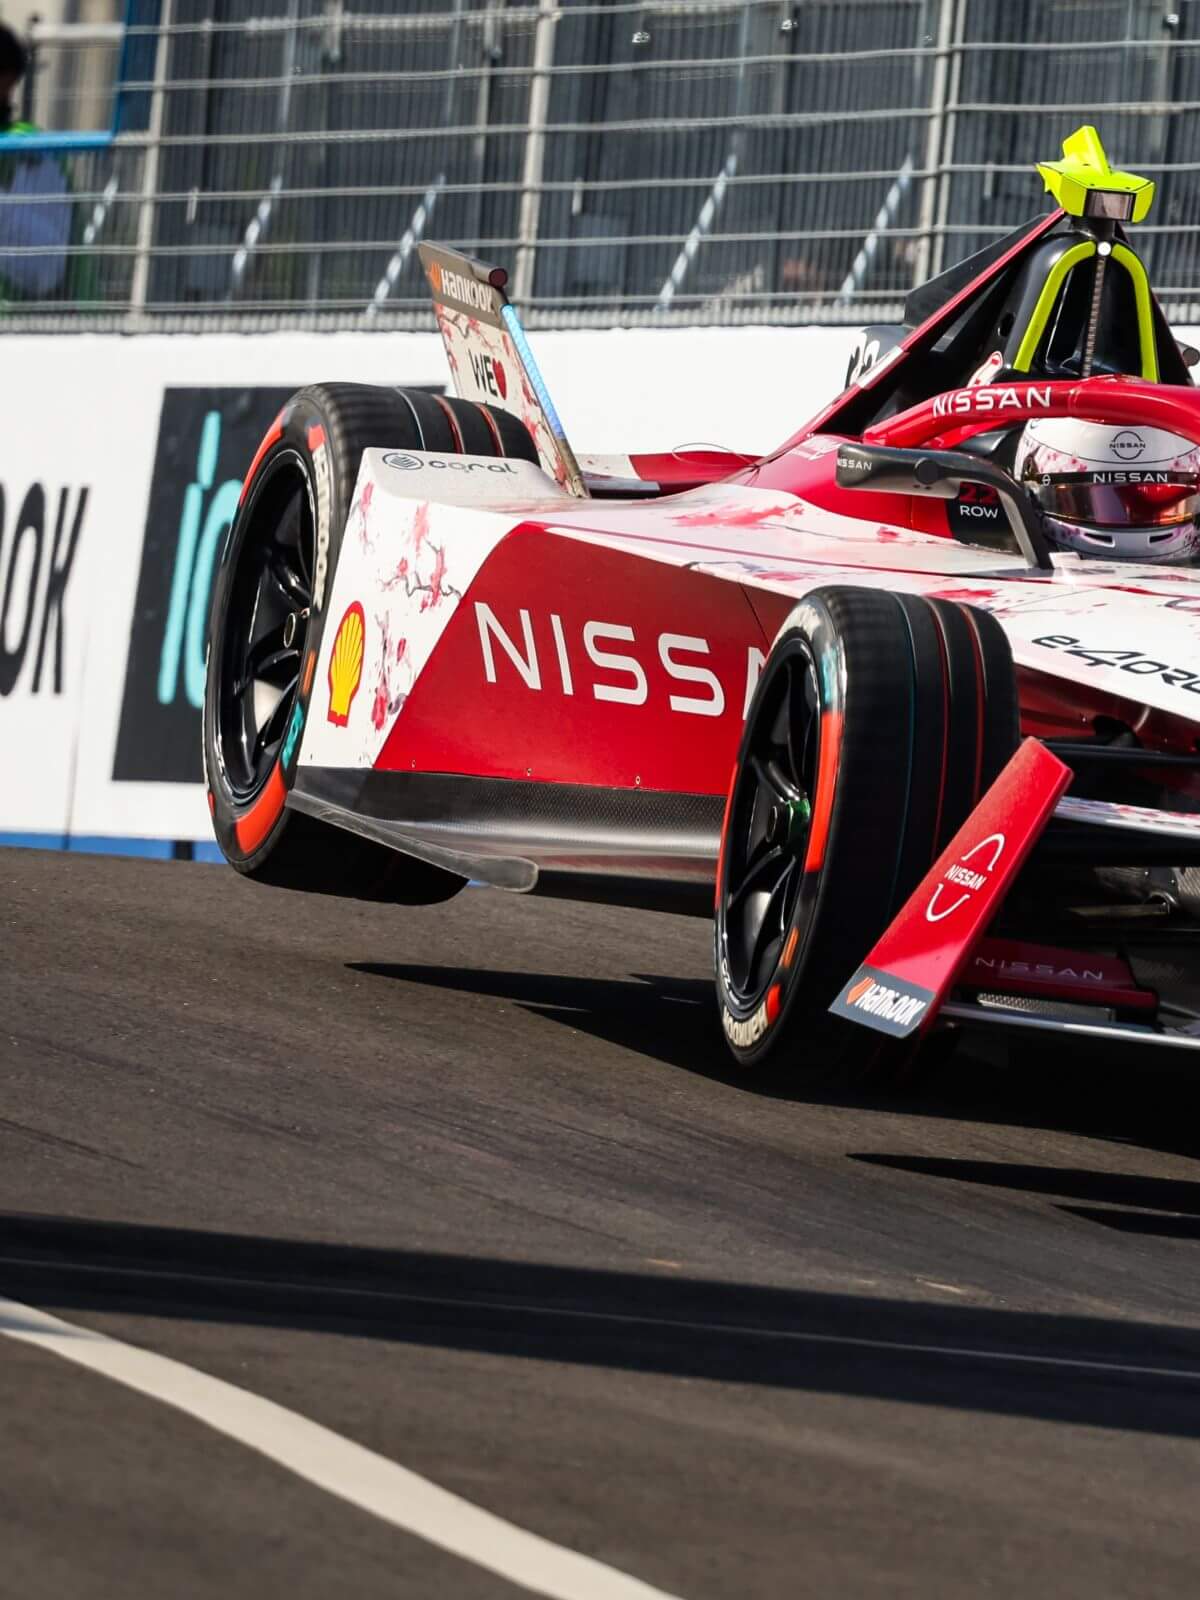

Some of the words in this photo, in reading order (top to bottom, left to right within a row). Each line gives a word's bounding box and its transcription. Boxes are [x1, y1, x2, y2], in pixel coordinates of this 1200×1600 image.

[468, 348, 498, 397] WE
[932, 386, 1052, 418] NISSAN
[1093, 472, 1168, 483] NISSAN
[960, 505, 998, 518] ROW
[0, 482, 89, 697] OK
[474, 601, 768, 721] NISS
[944, 864, 987, 890] NISSAN
[976, 957, 1102, 980] NISSAN
